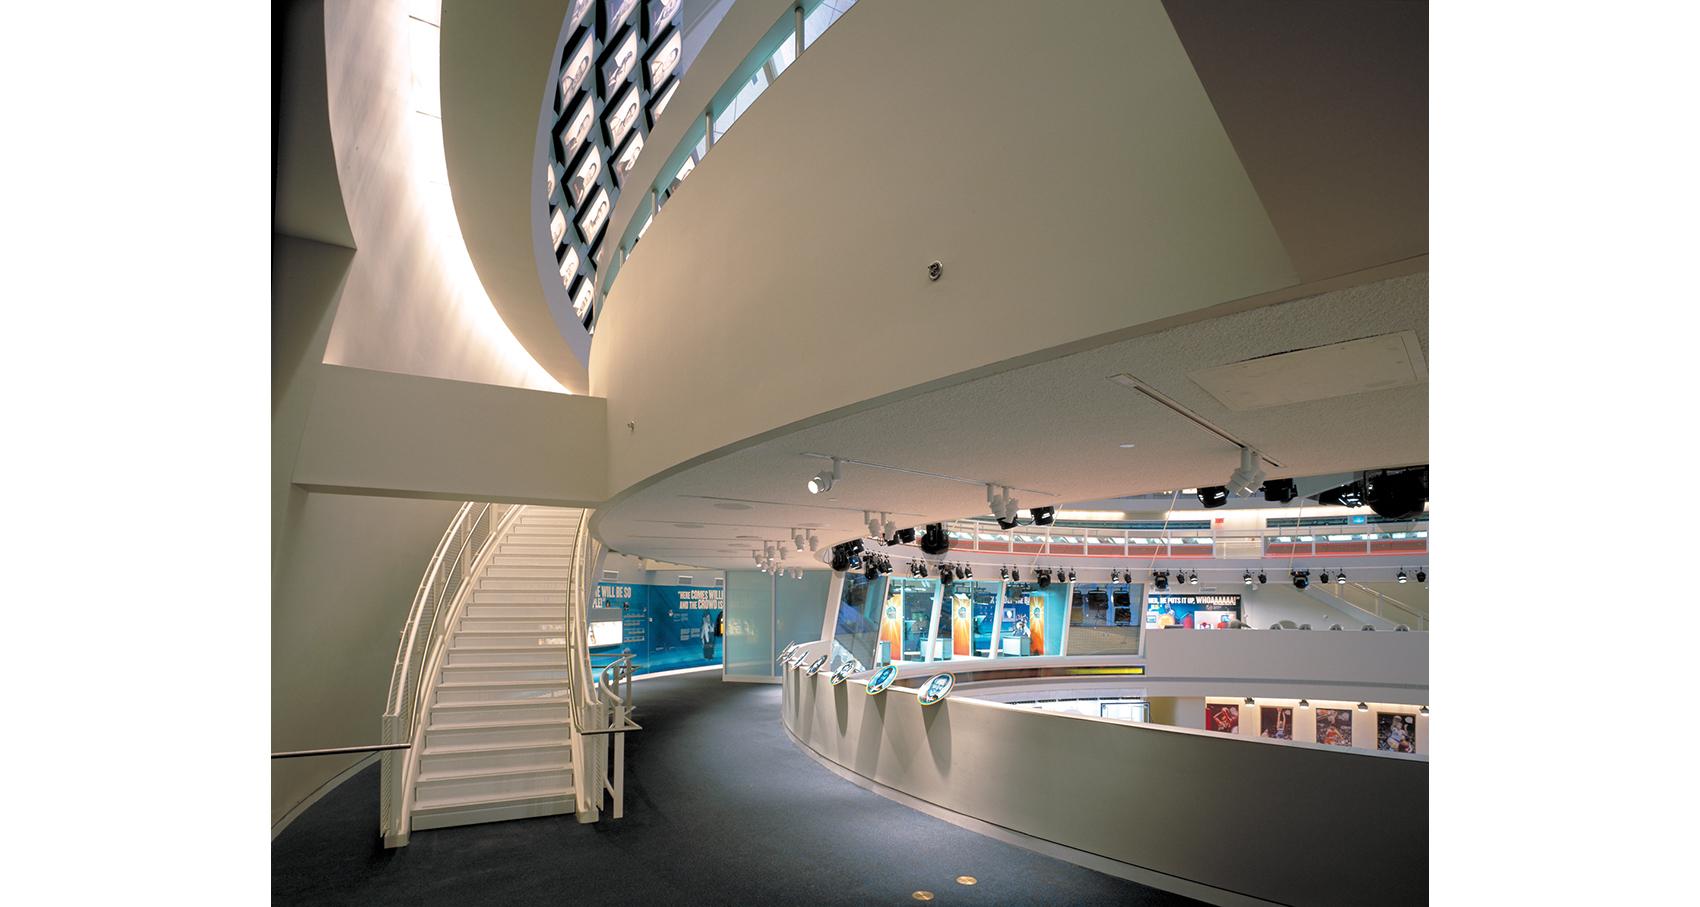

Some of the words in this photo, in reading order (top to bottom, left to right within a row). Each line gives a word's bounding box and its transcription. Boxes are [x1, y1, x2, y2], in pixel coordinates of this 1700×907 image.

[601, 585, 615, 598] WILL
[616, 586, 623, 598] BE
[623, 586, 632, 599] SO
[691, 590, 708, 600] COMES
[679, 601, 688, 609] AND
[689, 601, 697, 609] THE
[698, 599, 717, 609] CROWD
